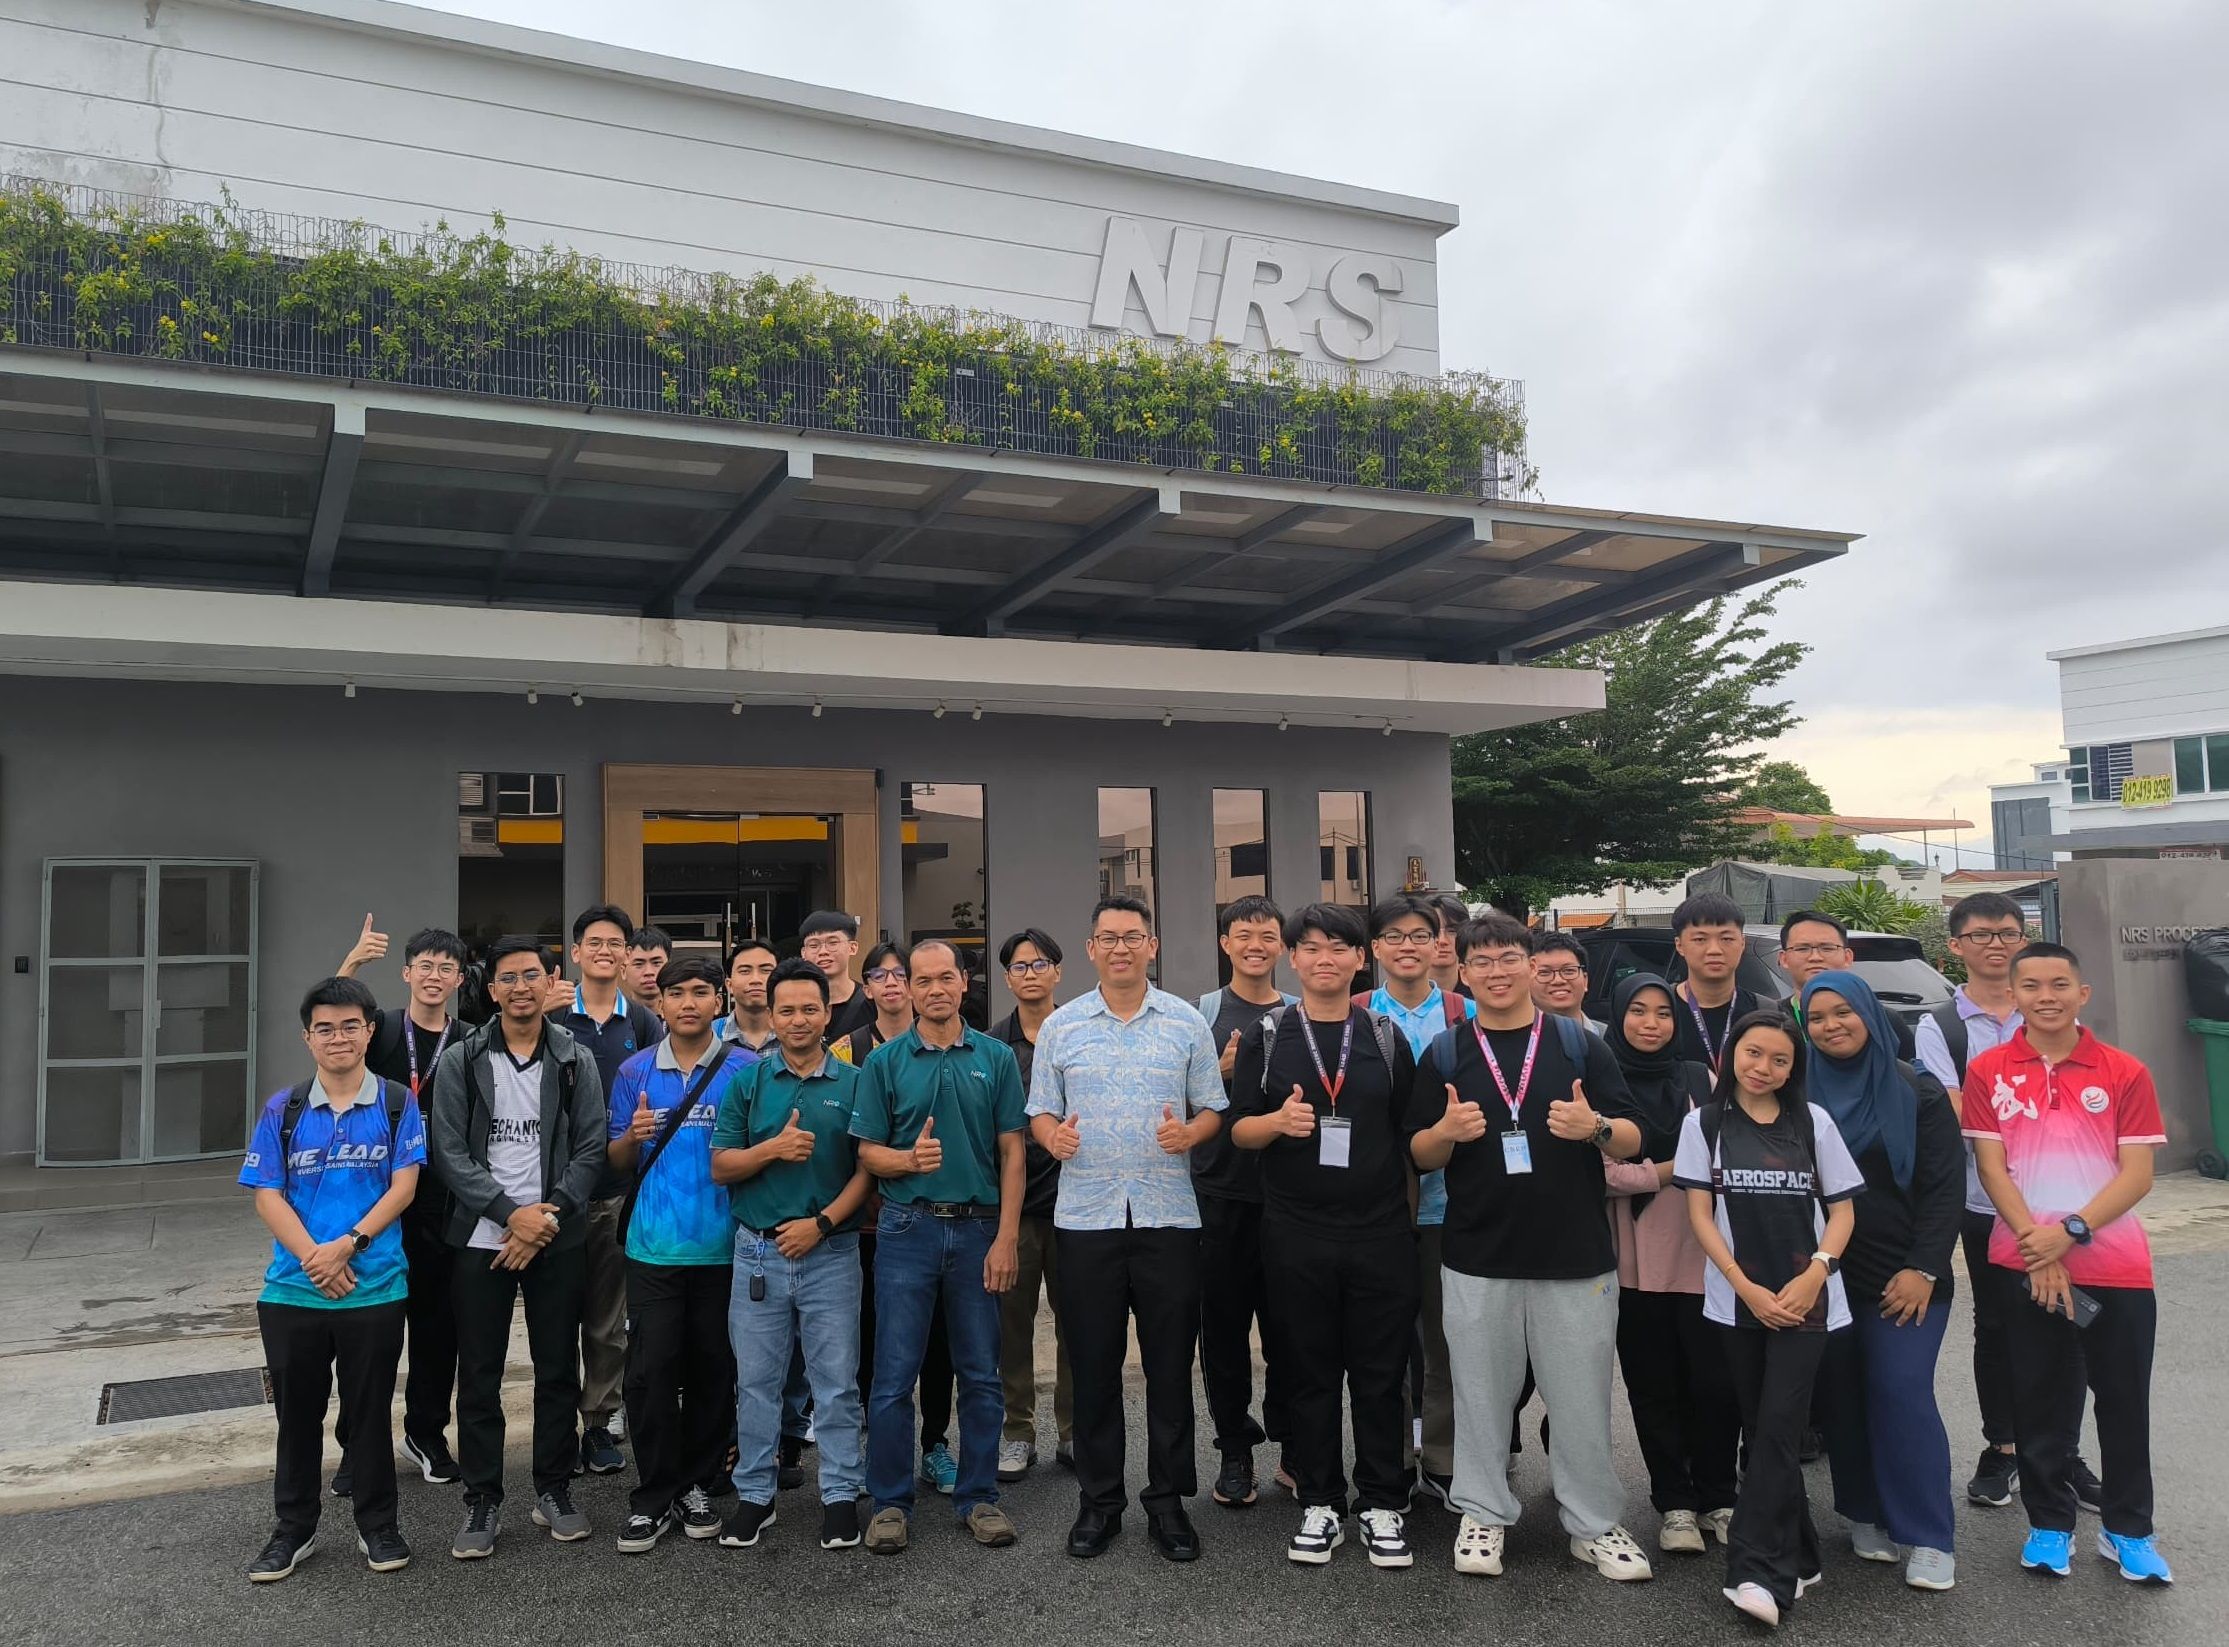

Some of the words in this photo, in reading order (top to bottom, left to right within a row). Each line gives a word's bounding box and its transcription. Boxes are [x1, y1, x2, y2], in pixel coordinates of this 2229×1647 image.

[1088, 215, 1404, 362] NRS
[2120, 925, 2150, 944] NRS
[489, 1118, 540, 1136] ECHANIC
[287, 1149, 321, 1169] WE
[325, 1143, 389, 1161] LEAD
